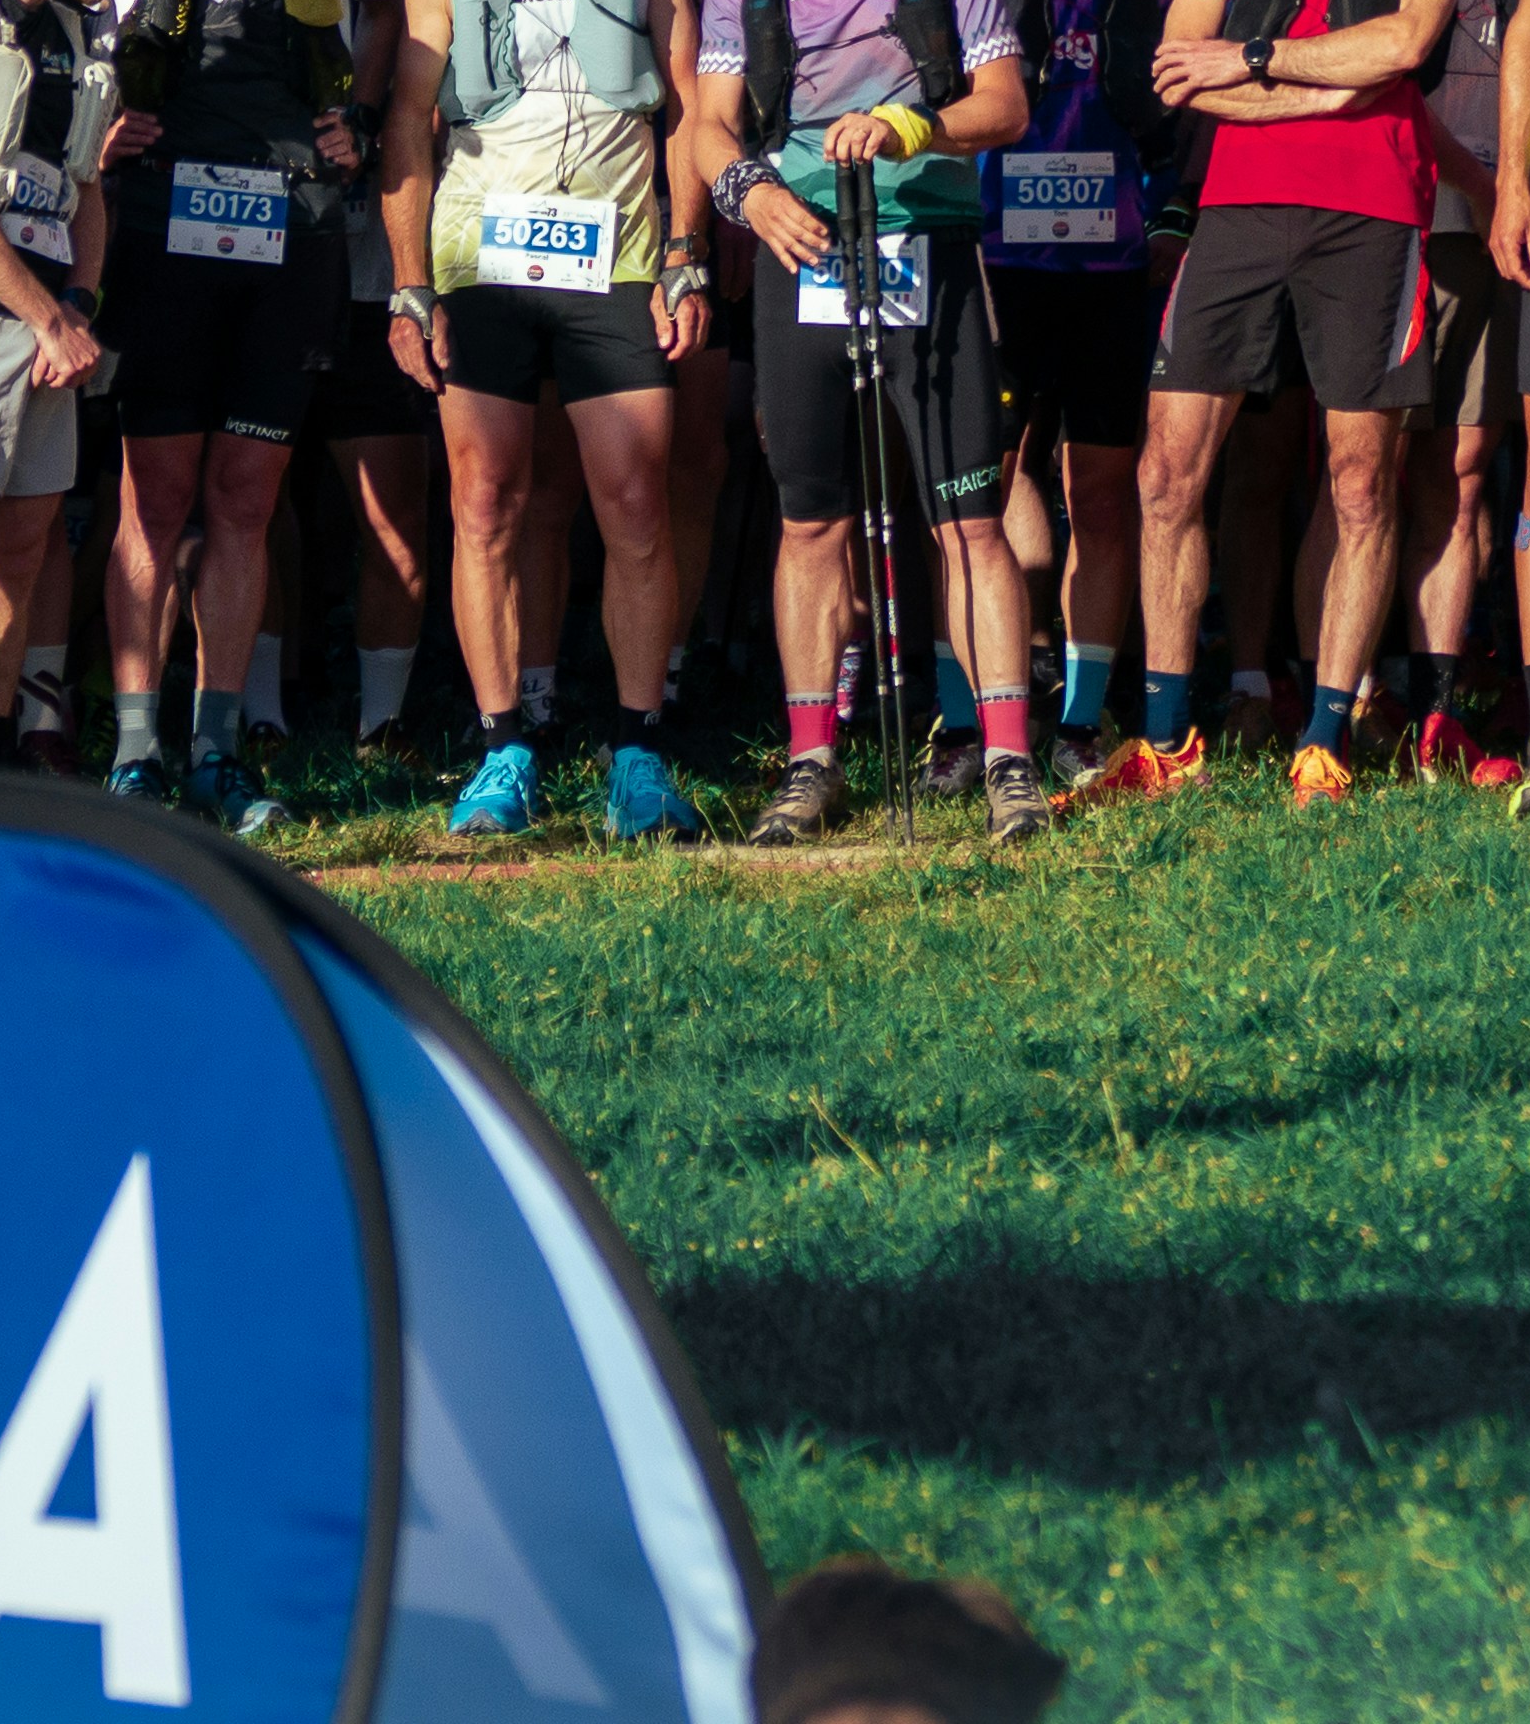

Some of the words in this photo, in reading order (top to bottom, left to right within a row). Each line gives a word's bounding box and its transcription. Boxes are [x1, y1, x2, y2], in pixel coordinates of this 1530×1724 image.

[189, 189, 273, 223] 50173
[1017, 178, 1105, 204] 50307
[493, 217, 588, 251] 50263
[812, 257, 902, 286] 500
